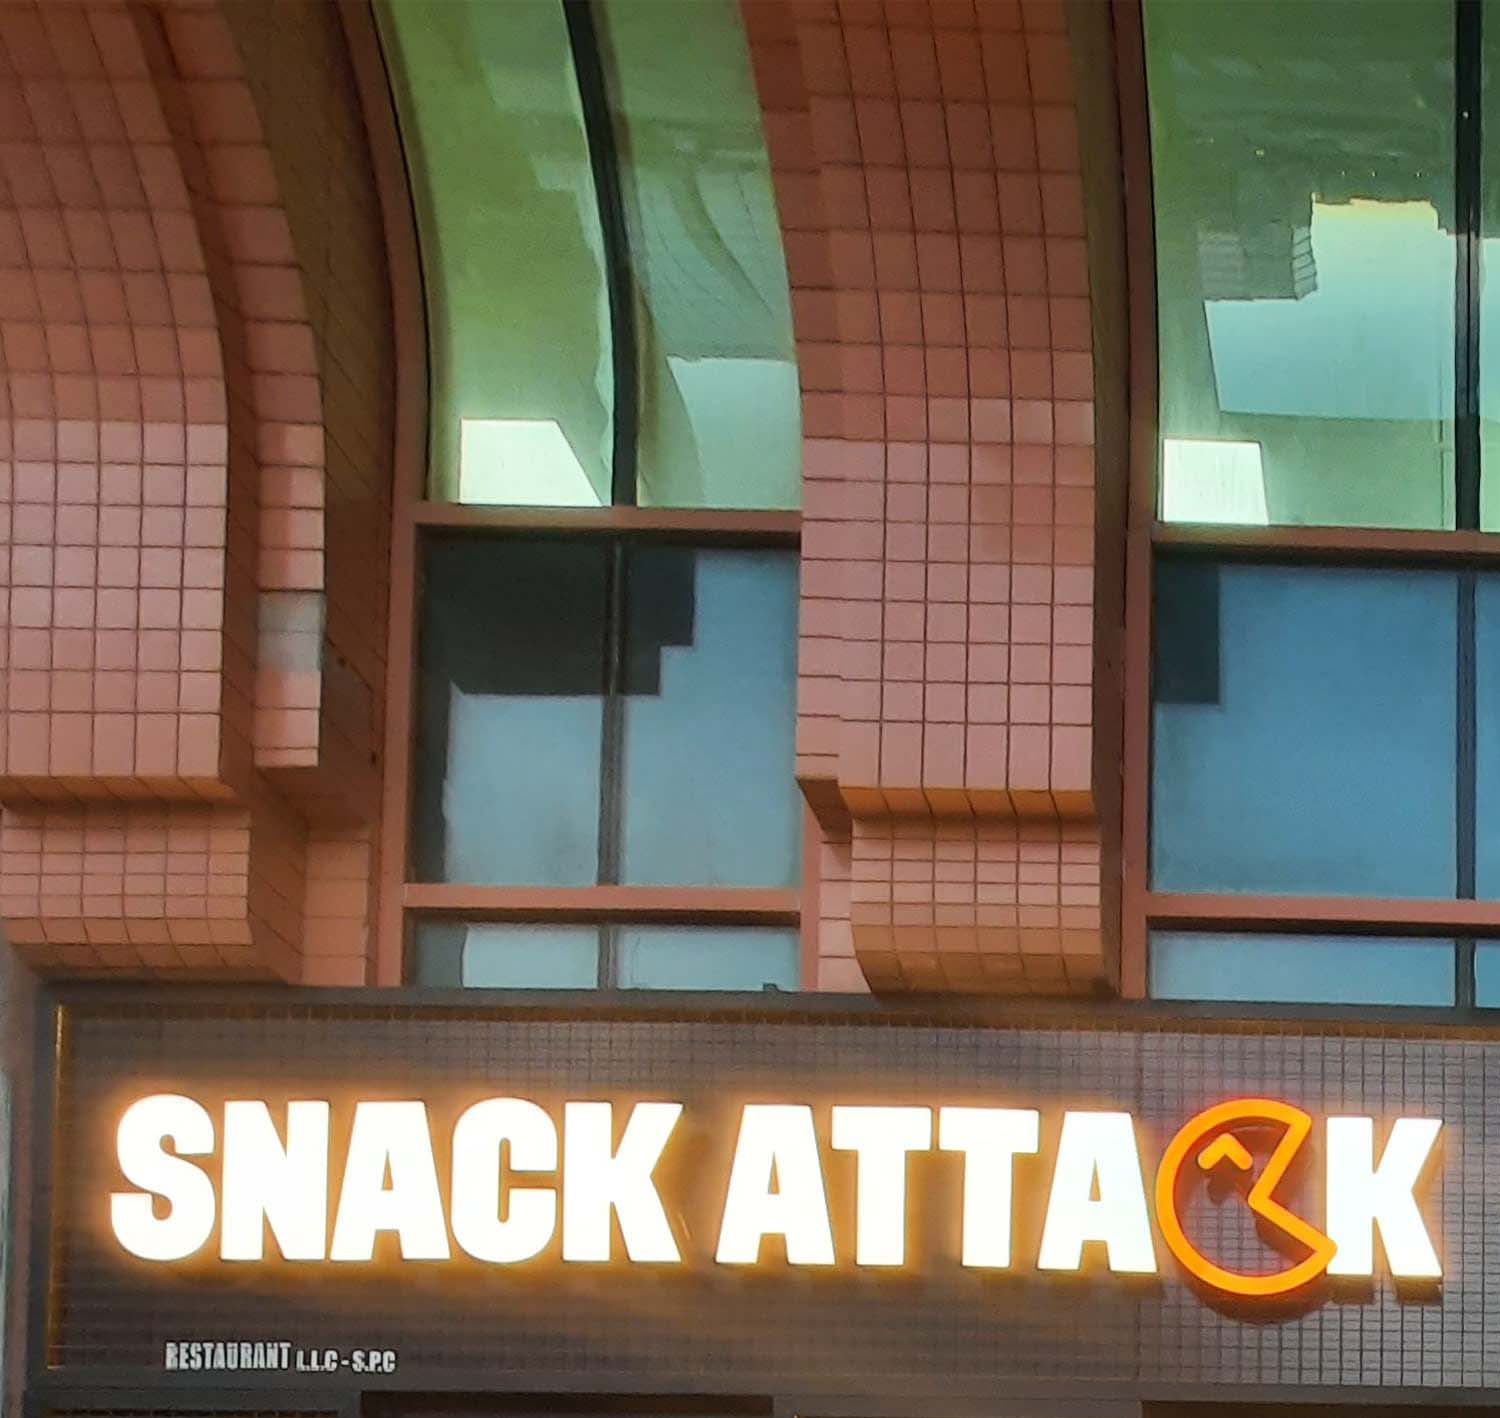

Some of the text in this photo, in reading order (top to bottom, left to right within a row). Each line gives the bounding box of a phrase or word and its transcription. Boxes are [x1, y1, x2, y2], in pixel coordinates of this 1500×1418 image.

[110, 1094, 1444, 1295] SNACK ATTACK
[165, 1342, 292, 1370] RESTAURANT
